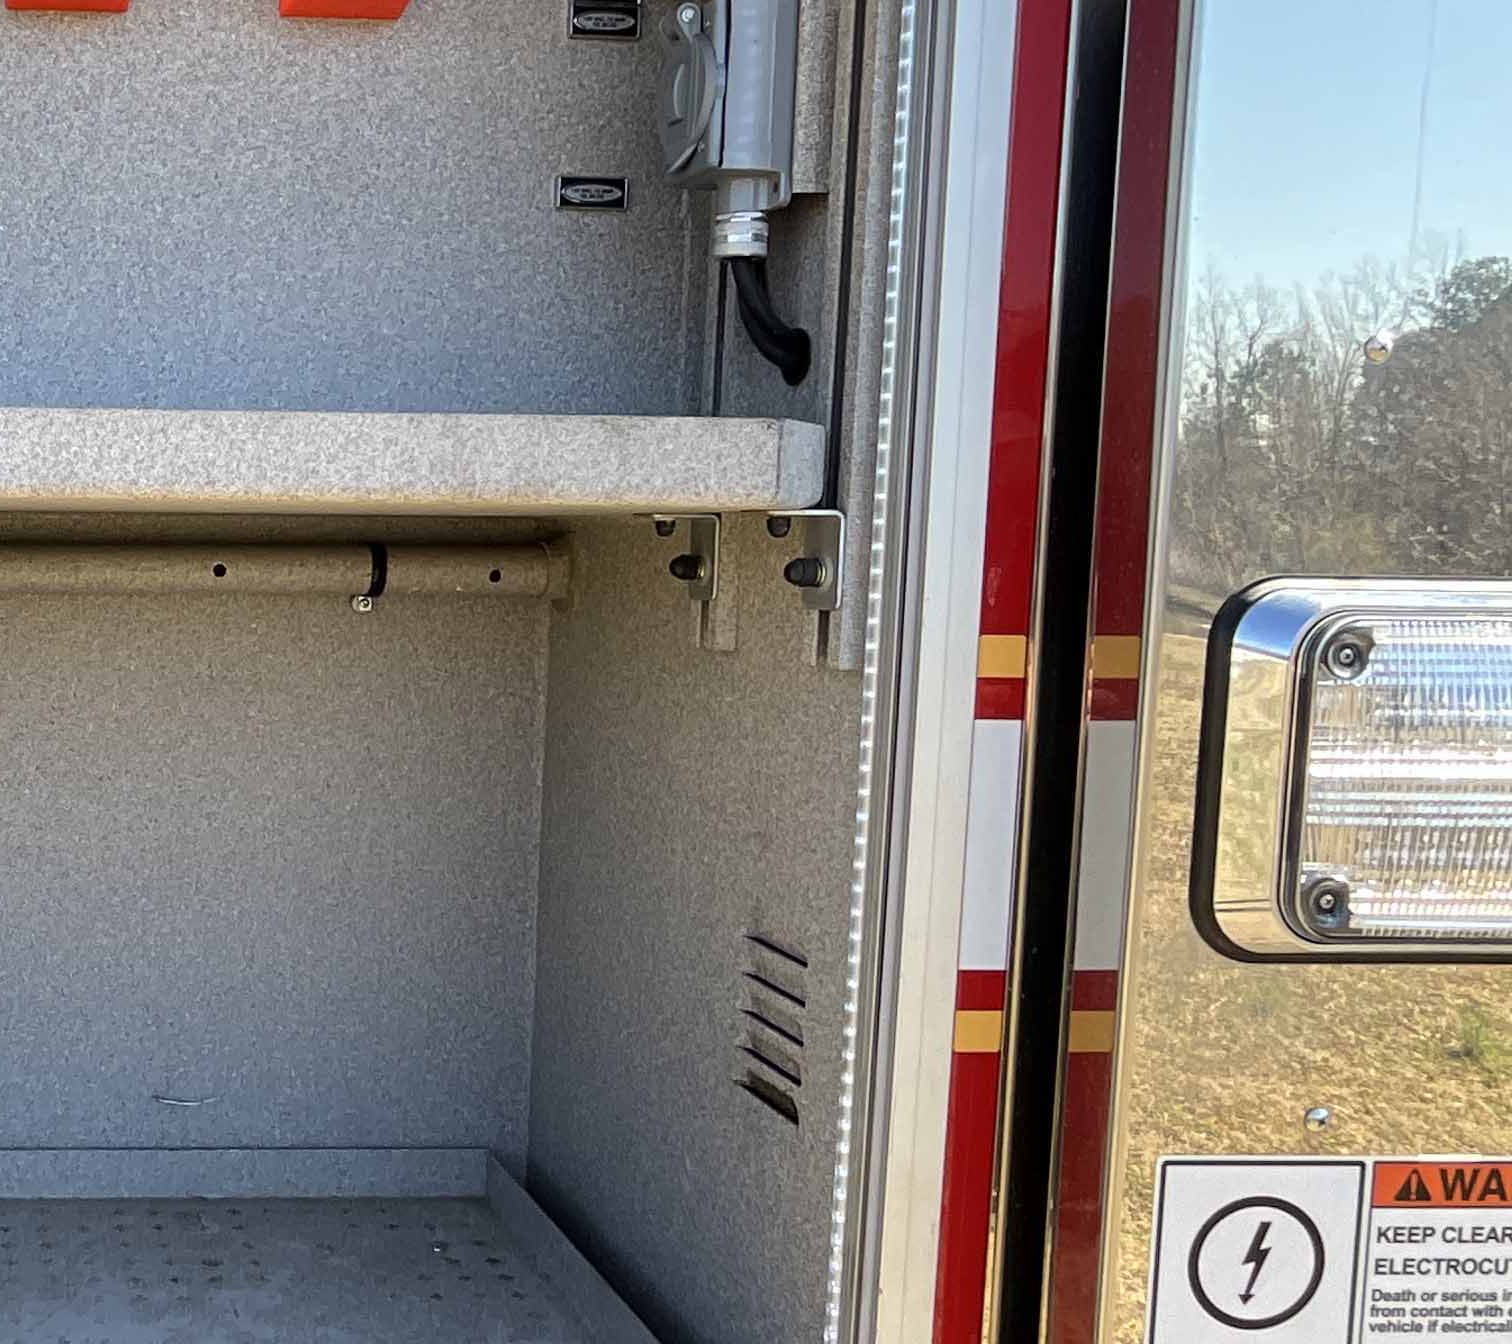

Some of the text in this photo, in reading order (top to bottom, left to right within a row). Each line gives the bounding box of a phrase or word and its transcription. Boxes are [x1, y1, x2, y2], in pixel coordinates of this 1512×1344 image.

[1376, 1226, 1436, 1244] KEEP
[1374, 1258, 1512, 1276] ELECTROCU
[1371, 1289, 1416, 1302] Death
[1420, 1292, 1437, 1302] or
[1441, 1289, 1497, 1302] serious
[1370, 1305, 1406, 1317] from
[1410, 1306, 1468, 1318] contact
[1471, 1305, 1504, 1318] with
[1369, 1321, 1423, 1333] vehicle
[1427, 1320, 1439, 1333] if
